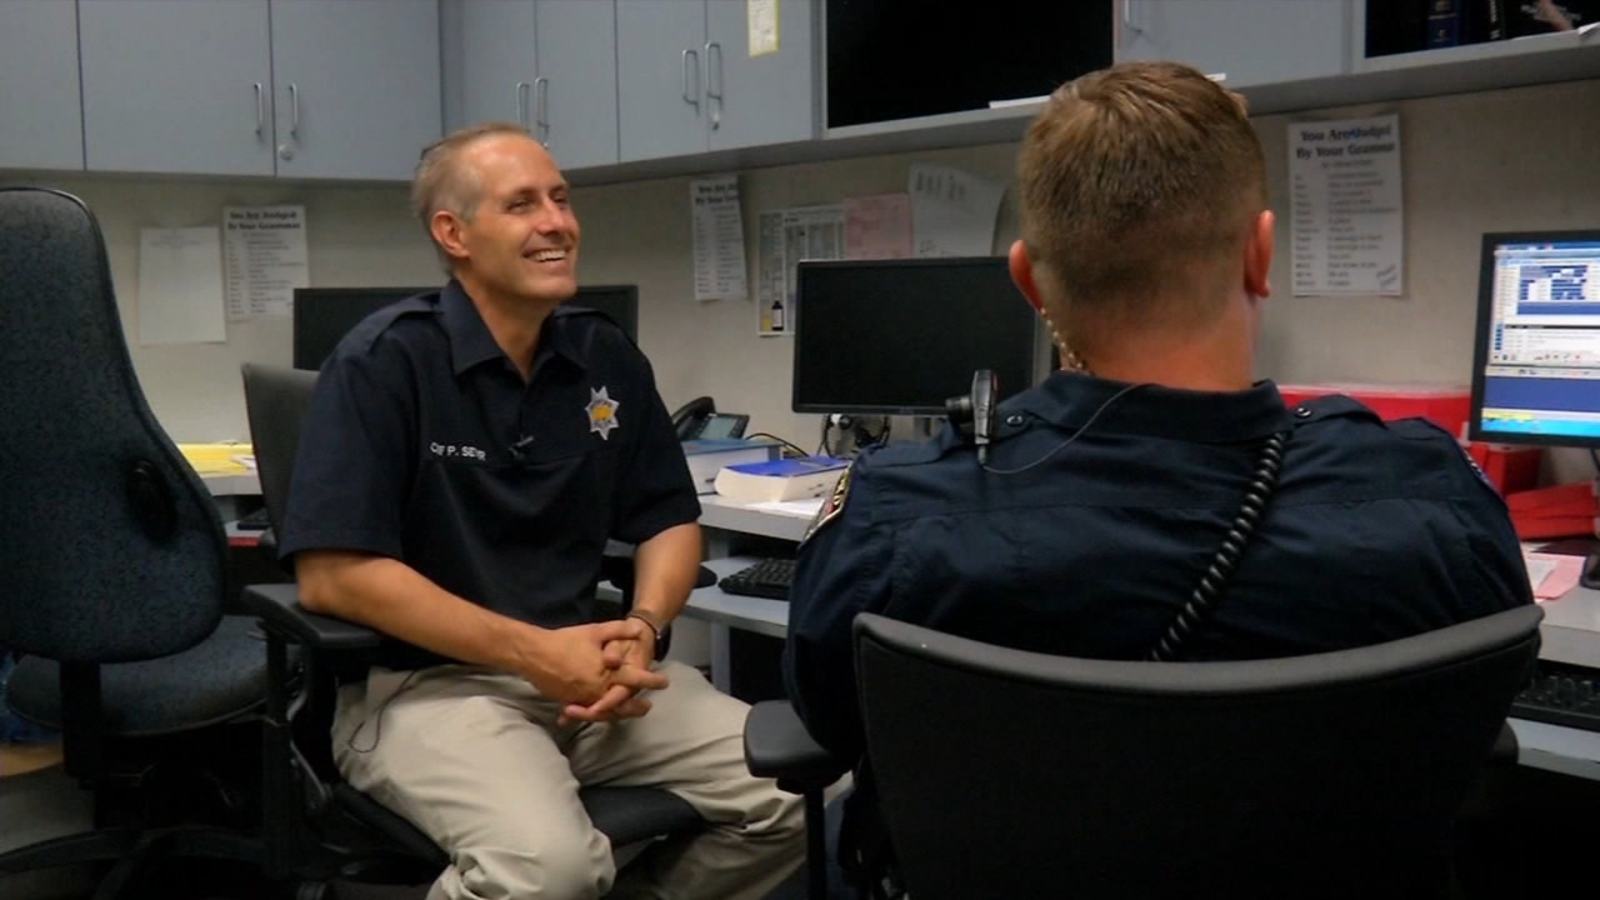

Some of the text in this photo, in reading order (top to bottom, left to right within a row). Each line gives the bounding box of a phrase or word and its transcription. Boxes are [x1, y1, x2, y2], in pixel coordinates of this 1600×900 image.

[1301, 129, 1325, 142] You
[1296, 148, 1313, 160] By
[1315, 147, 1345, 157] Your
